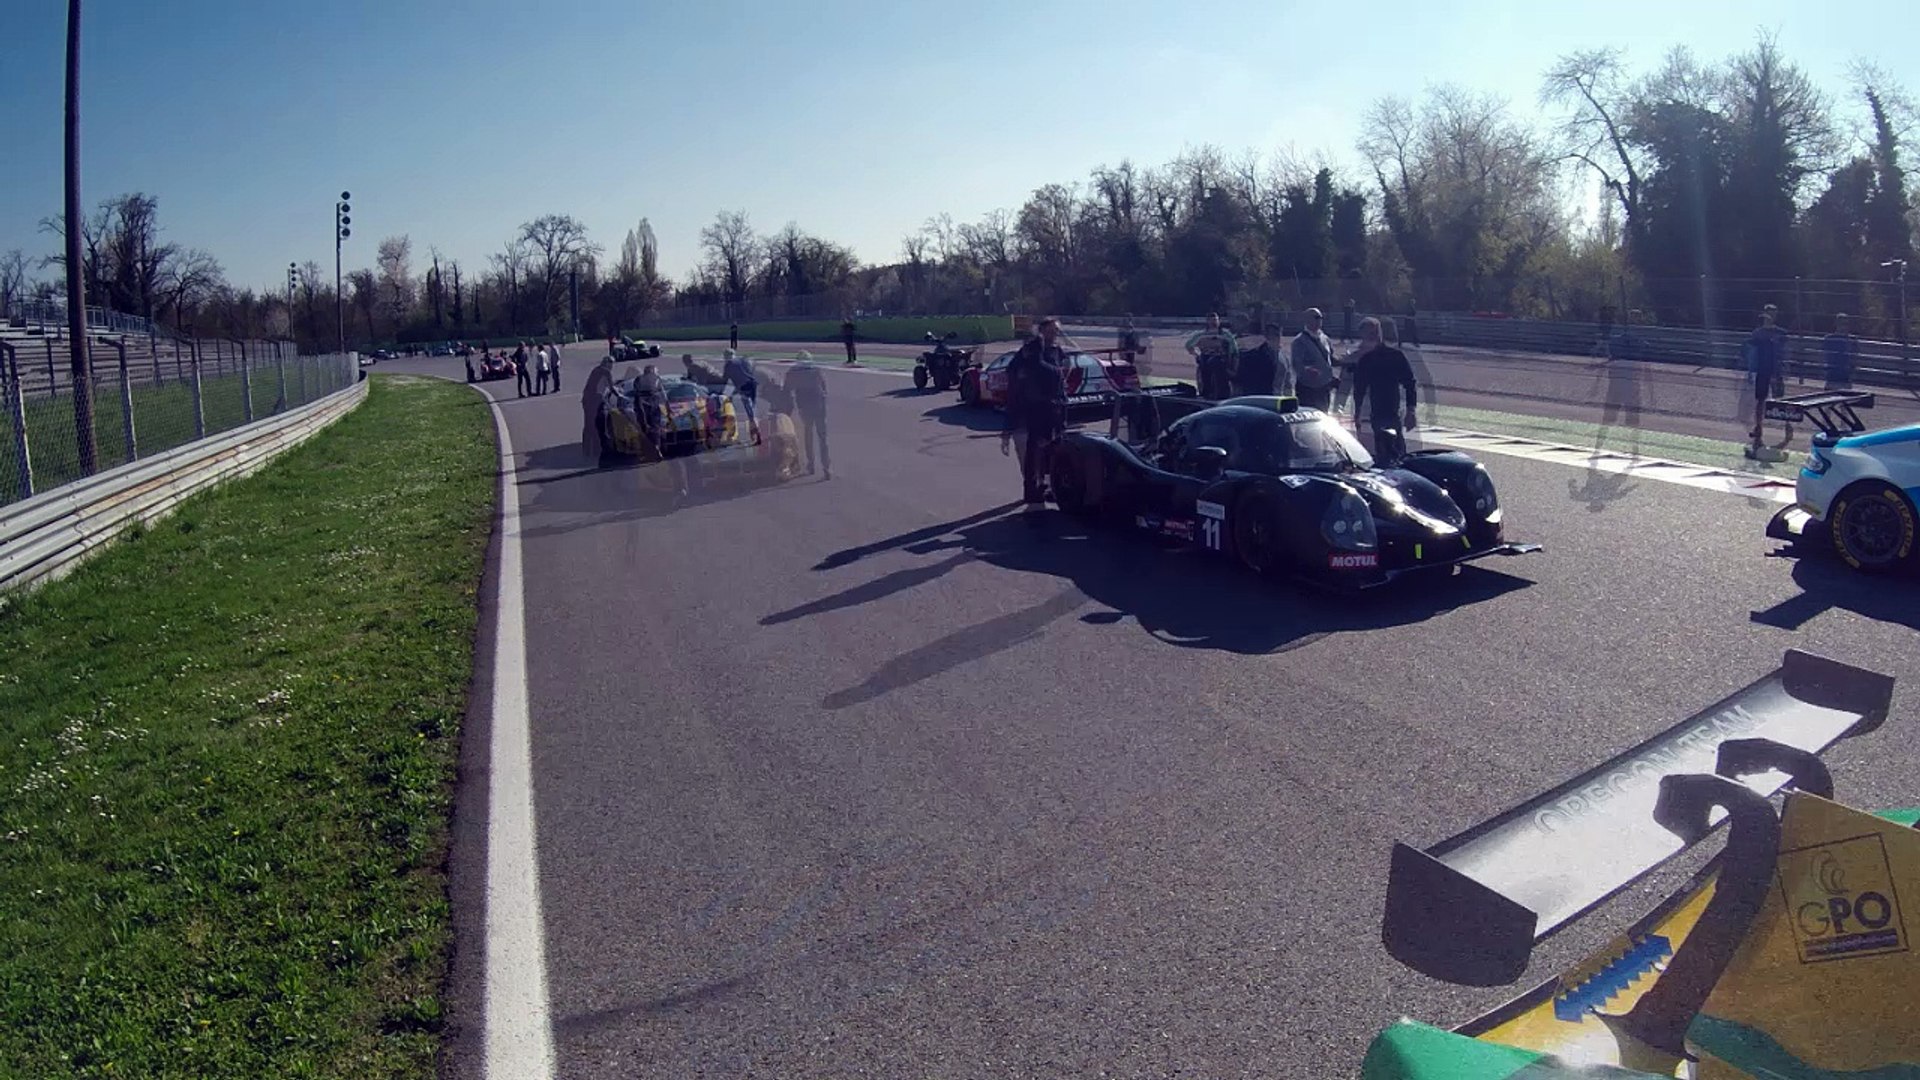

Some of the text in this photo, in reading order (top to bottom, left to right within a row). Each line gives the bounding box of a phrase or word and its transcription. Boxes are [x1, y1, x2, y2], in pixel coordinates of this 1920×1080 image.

[1202, 518, 1220, 550] 11
[1331, 555, 1377, 567] MOTUL
[1534, 704, 1753, 834] OREGON TEAM
[1798, 891, 1892, 936] GPO
